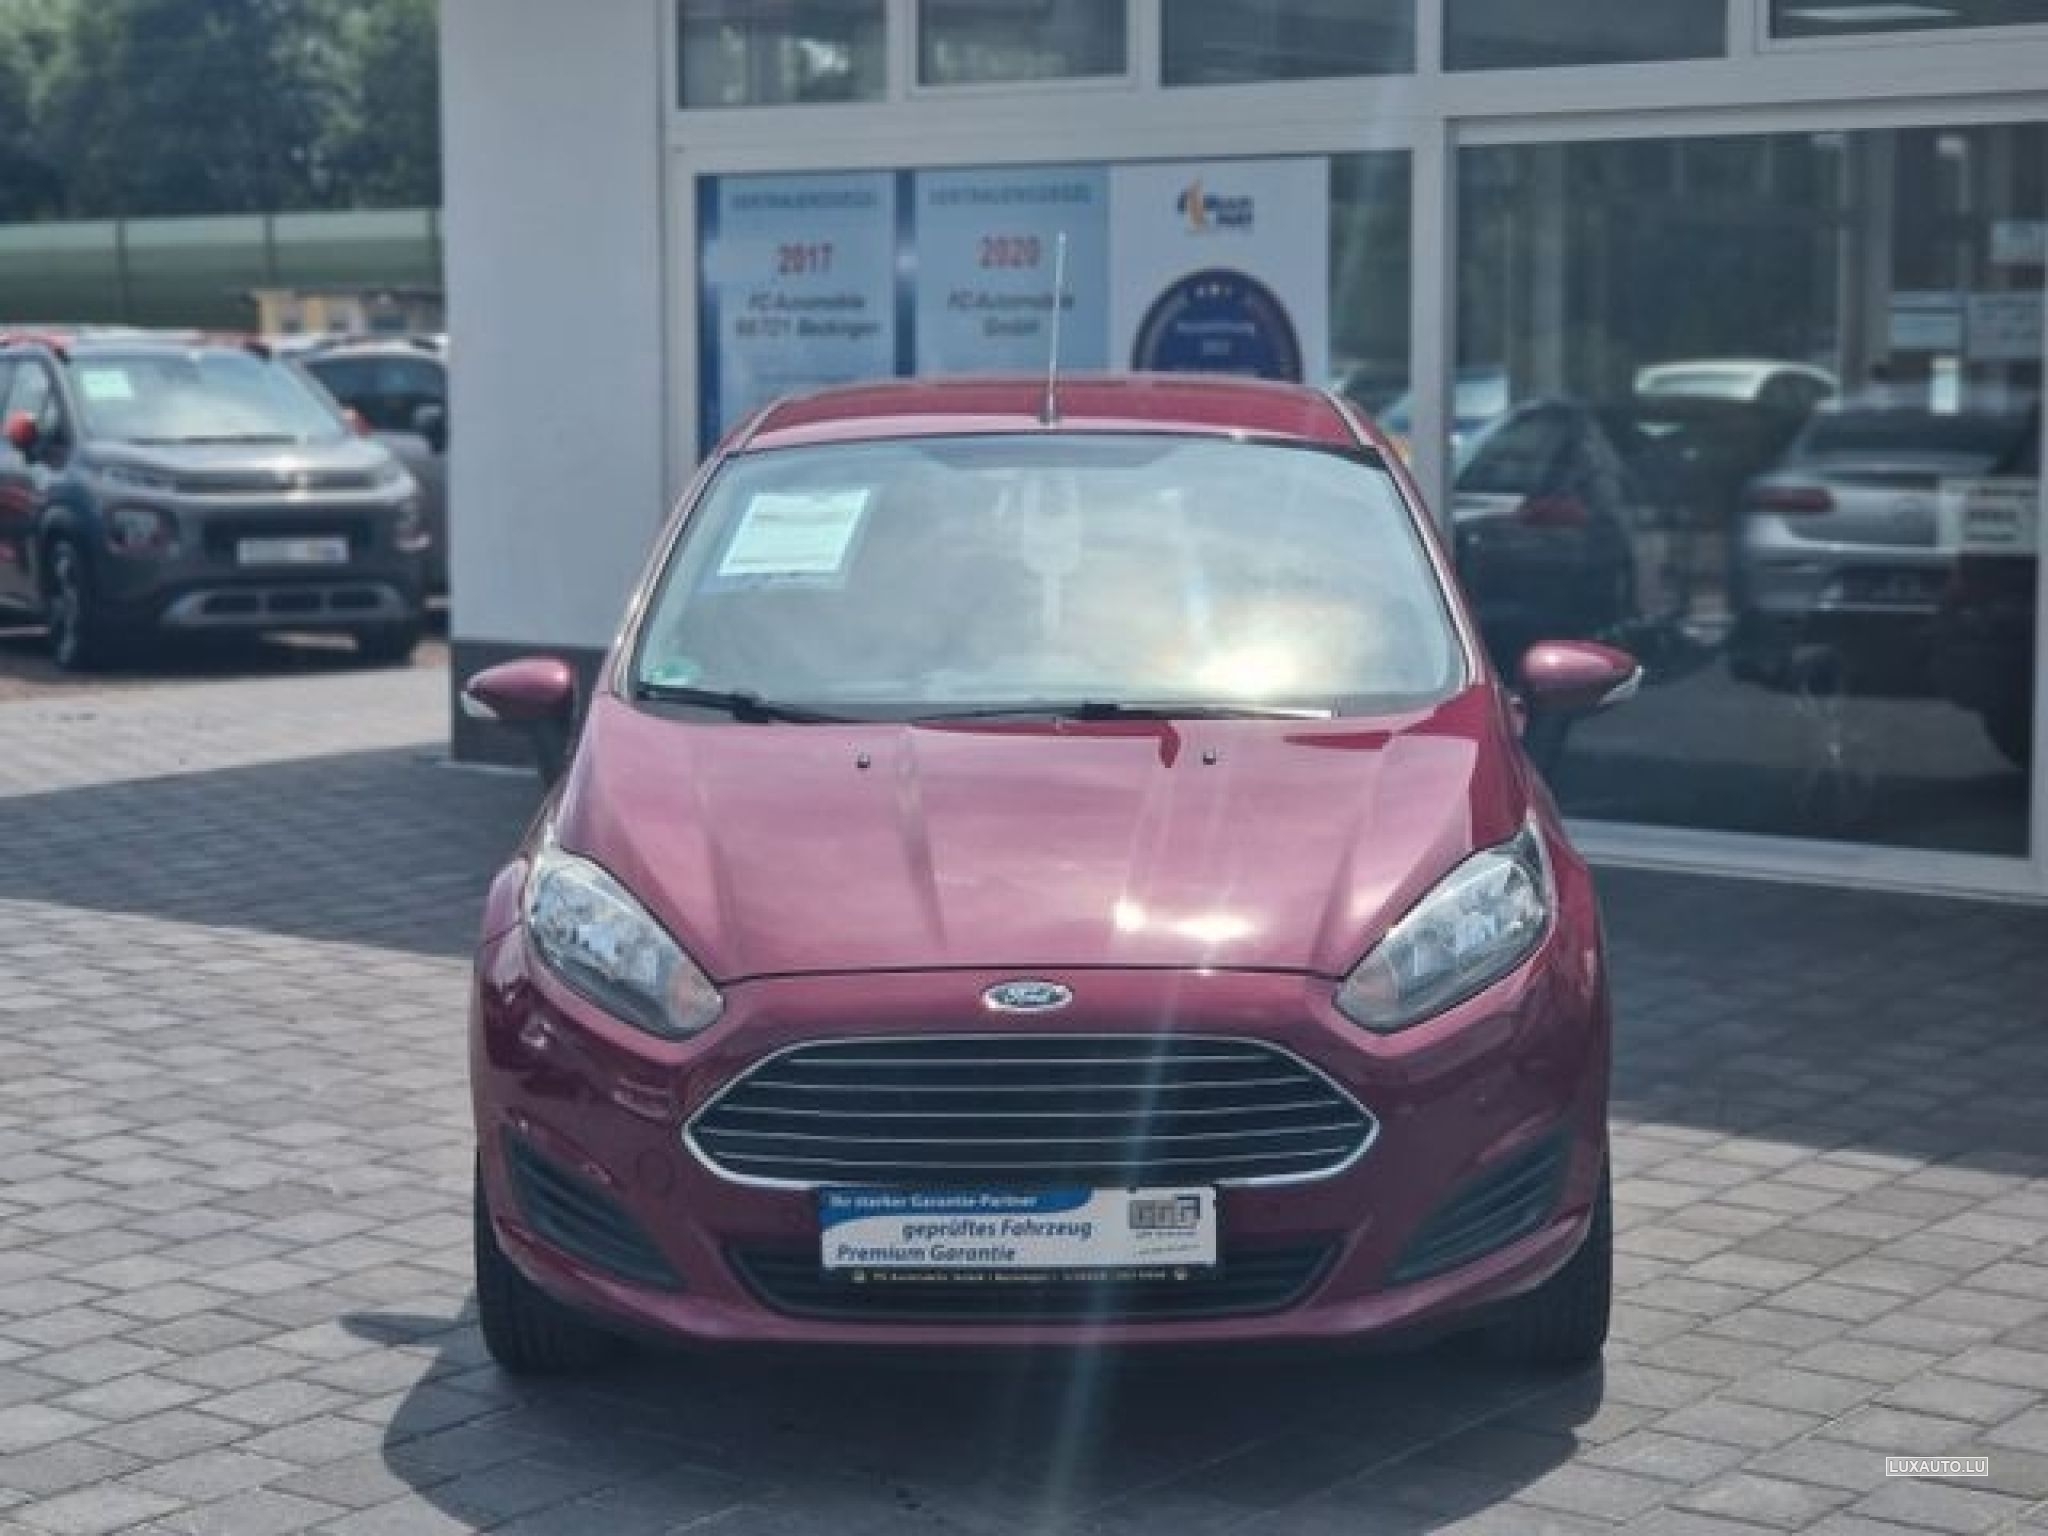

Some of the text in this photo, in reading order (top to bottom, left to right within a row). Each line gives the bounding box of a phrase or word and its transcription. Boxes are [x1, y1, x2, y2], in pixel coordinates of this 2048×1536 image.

[777, 242, 833, 275] 2017
[978, 234, 1042, 268] 2020
[902, 1218, 1093, 1241] geprüftes Fahrzeug
[836, 1244, 1017, 1262] Premium Garantie
